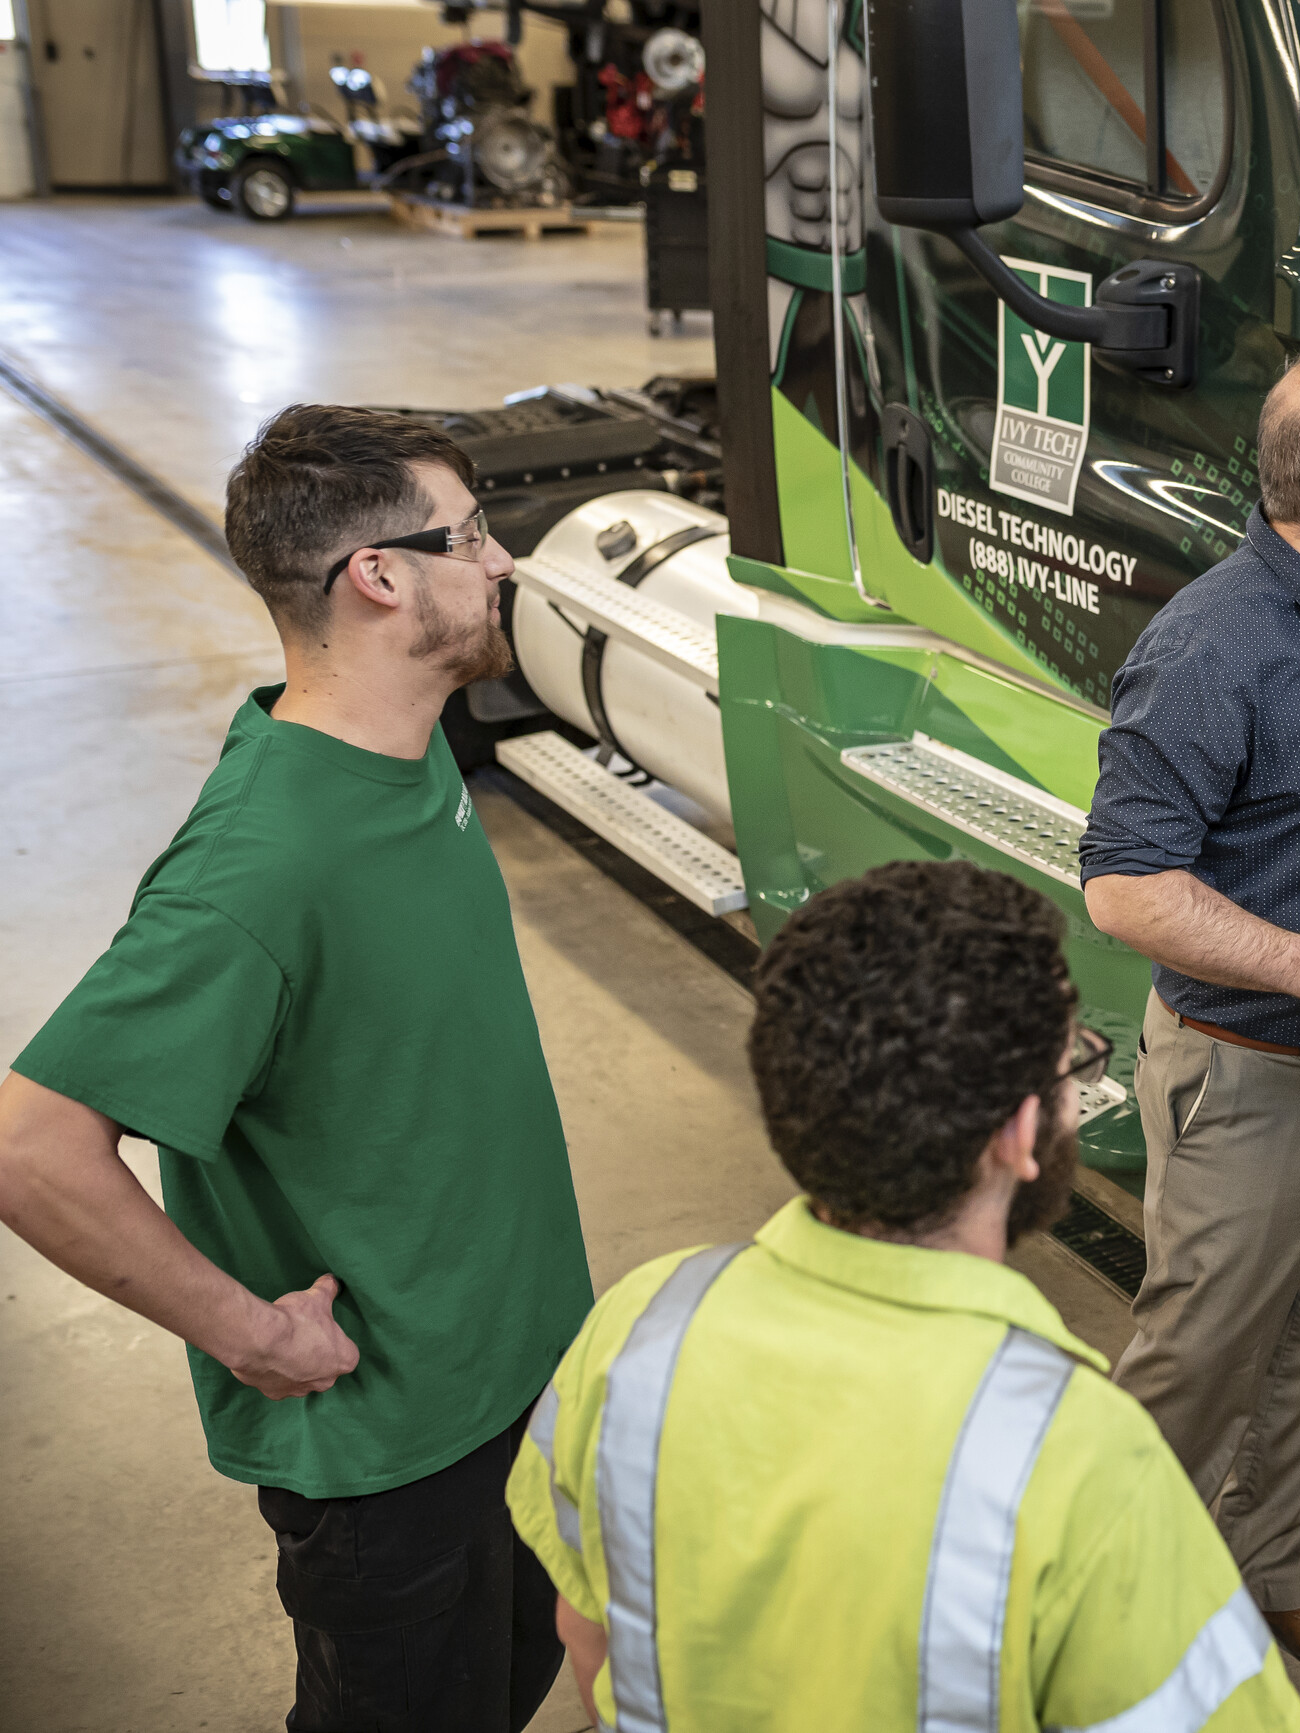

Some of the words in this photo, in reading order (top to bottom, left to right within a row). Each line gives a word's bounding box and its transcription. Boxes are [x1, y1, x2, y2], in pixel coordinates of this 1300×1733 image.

[1001, 416, 1032, 445] IVY
[1032, 424, 1079, 460] TECH
[1003, 450, 1065, 480] COMMUNITY
[1010, 468, 1052, 494] COLLEGE
[937, 488, 998, 537] DIESEL
[998, 510, 1138, 587] TECHNOLOGY
[969, 537, 1015, 584] (888)
[1017, 556, 1101, 615] IVY-LINE
